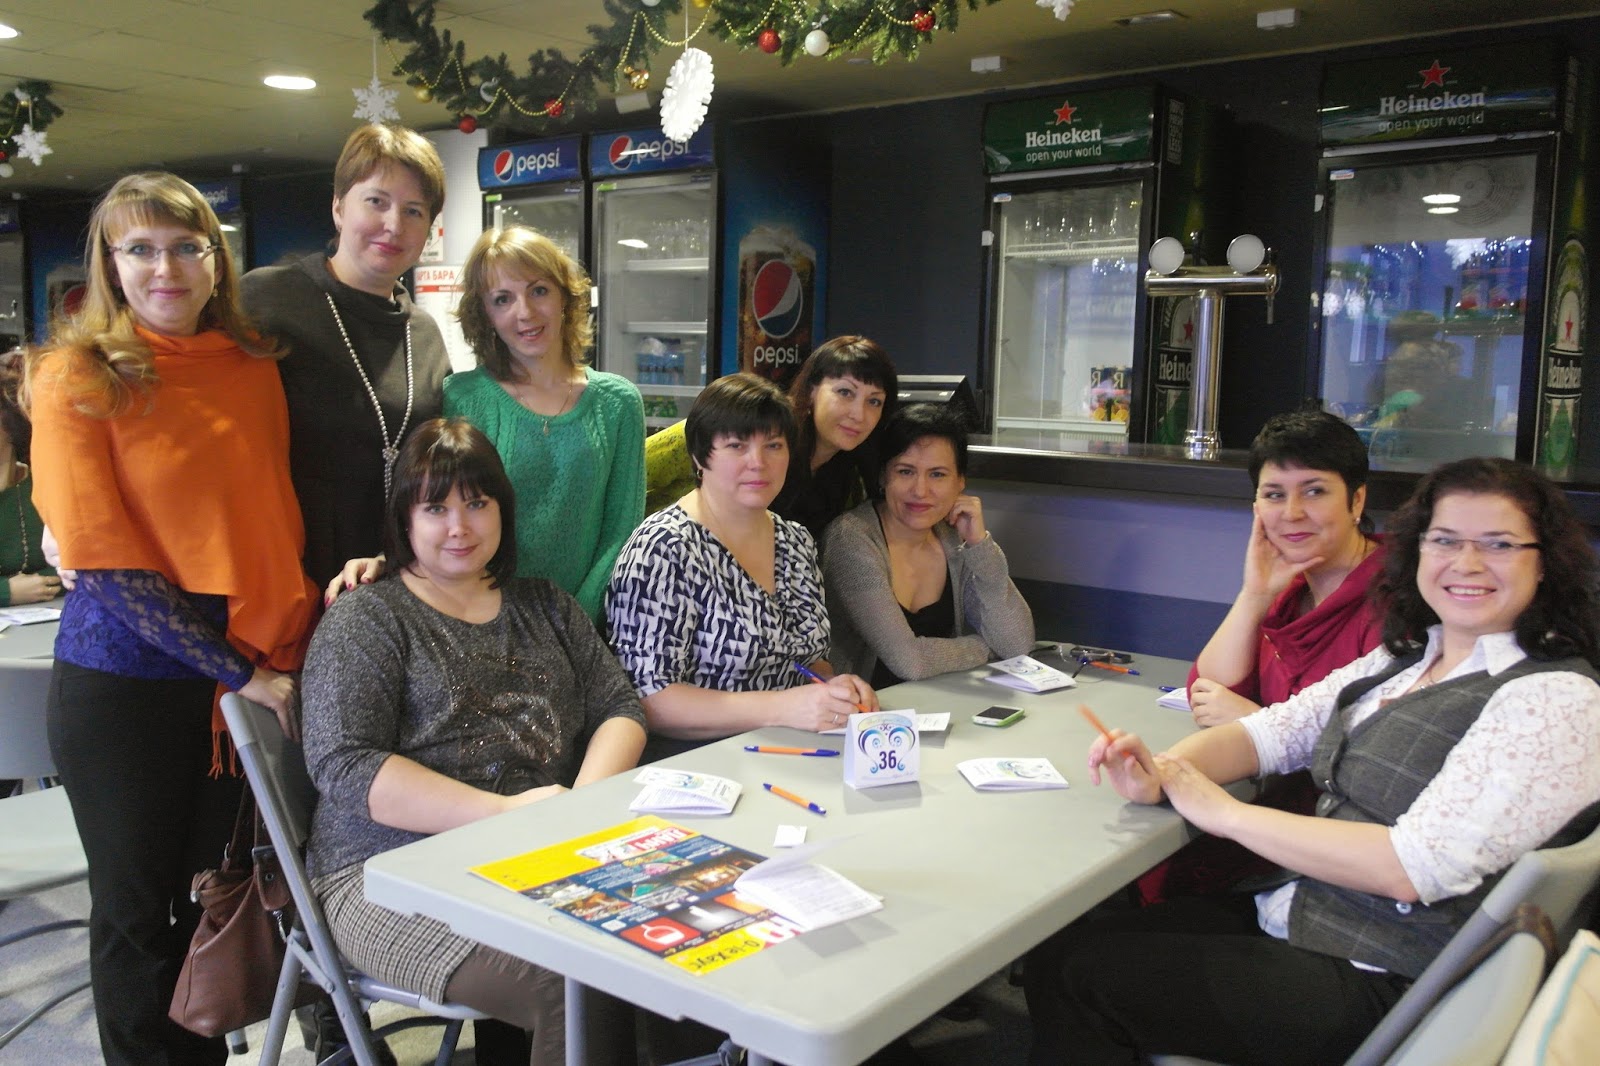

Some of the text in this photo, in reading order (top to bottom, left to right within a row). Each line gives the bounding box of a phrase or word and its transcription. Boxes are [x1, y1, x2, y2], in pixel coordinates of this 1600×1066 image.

[1379, 91, 1486, 116] Heineken
[1379, 110, 1485, 133] open your world
[1025, 127, 1102, 148] Heineken
[516, 147, 560, 177] pepsi
[636, 138, 690, 164] pepsi
[1025, 144, 1102, 164] open your world
[416, 269, 455, 281] АРТА БАРА
[753, 343, 800, 369] pepsi
[1159, 353, 1192, 382] Heine
[878, 749, 898, 770] 36
